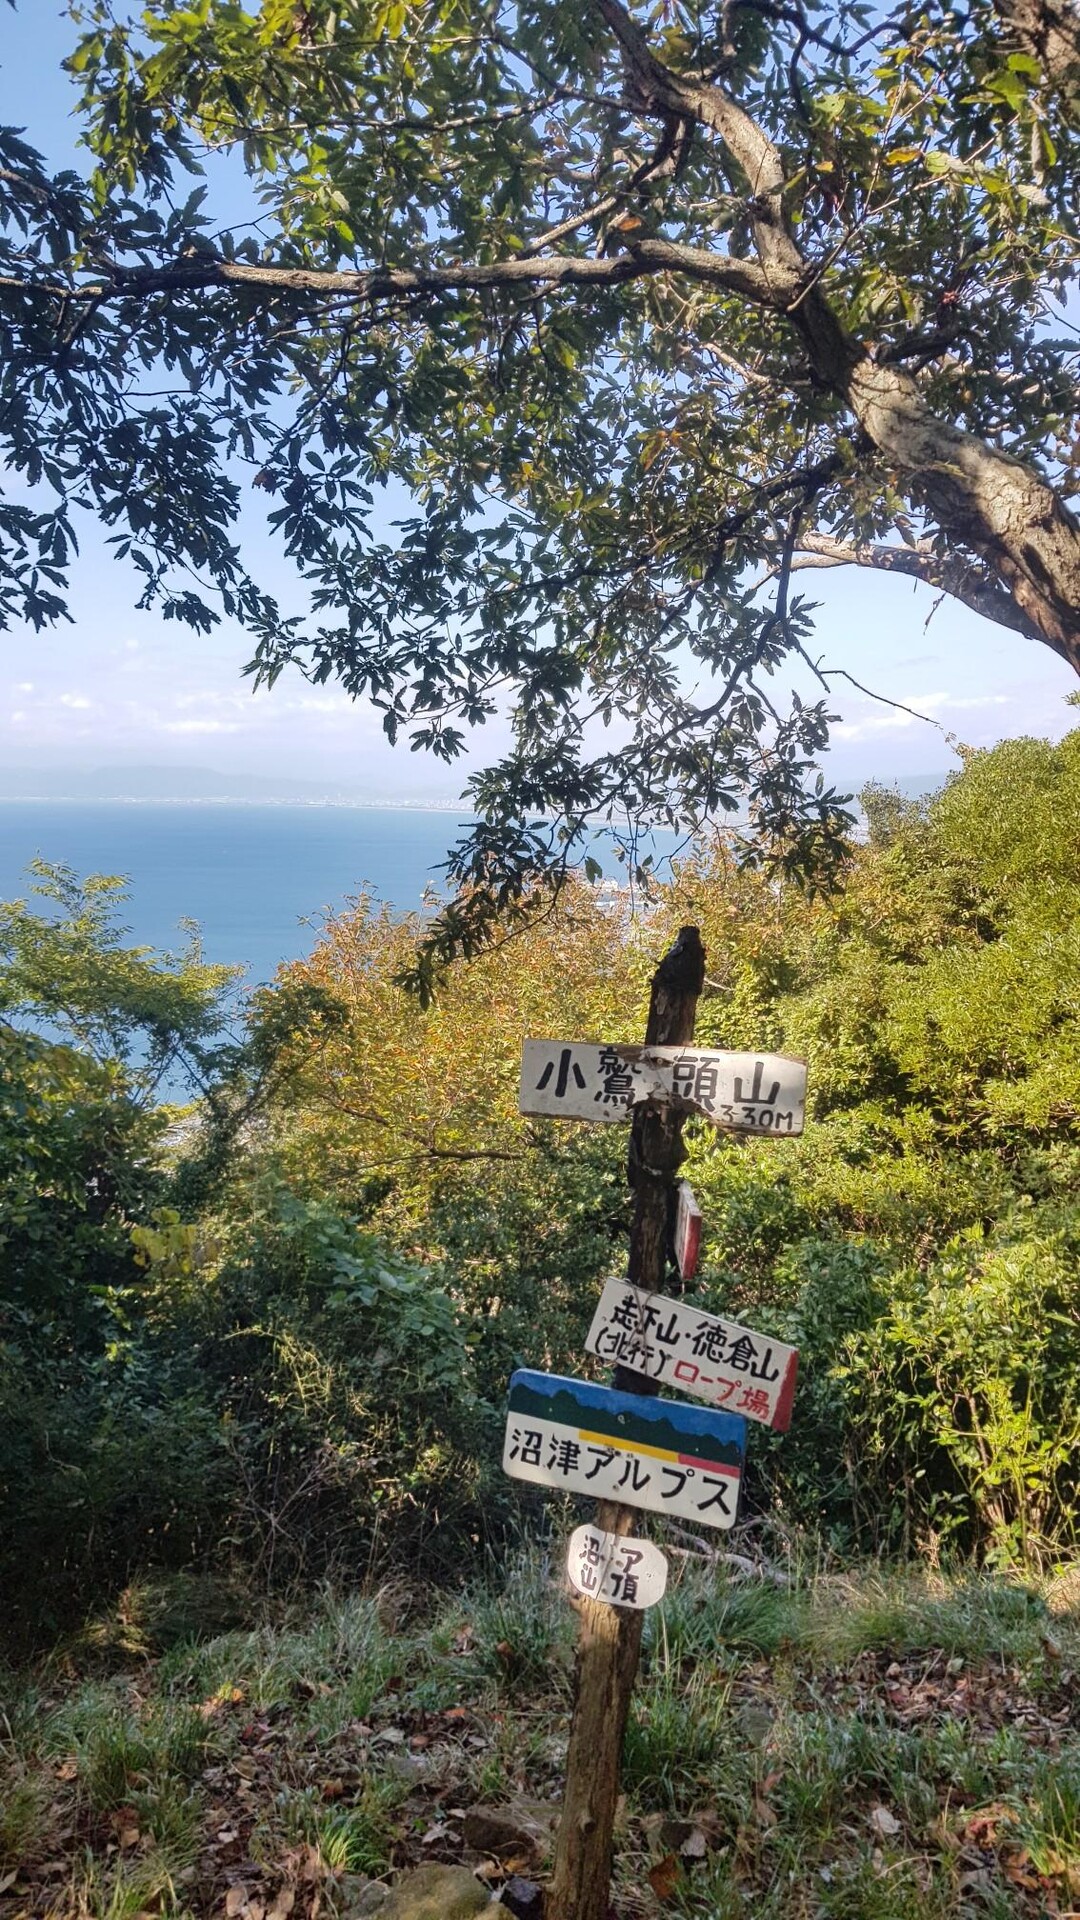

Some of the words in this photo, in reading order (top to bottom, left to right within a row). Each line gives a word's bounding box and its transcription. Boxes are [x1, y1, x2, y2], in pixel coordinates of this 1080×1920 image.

[535, 1046, 780, 1113] 小鷲頭山
[673, 1360, 771, 1419] ロープ場
[509, 1427, 731, 1516] 沼津アルプス
